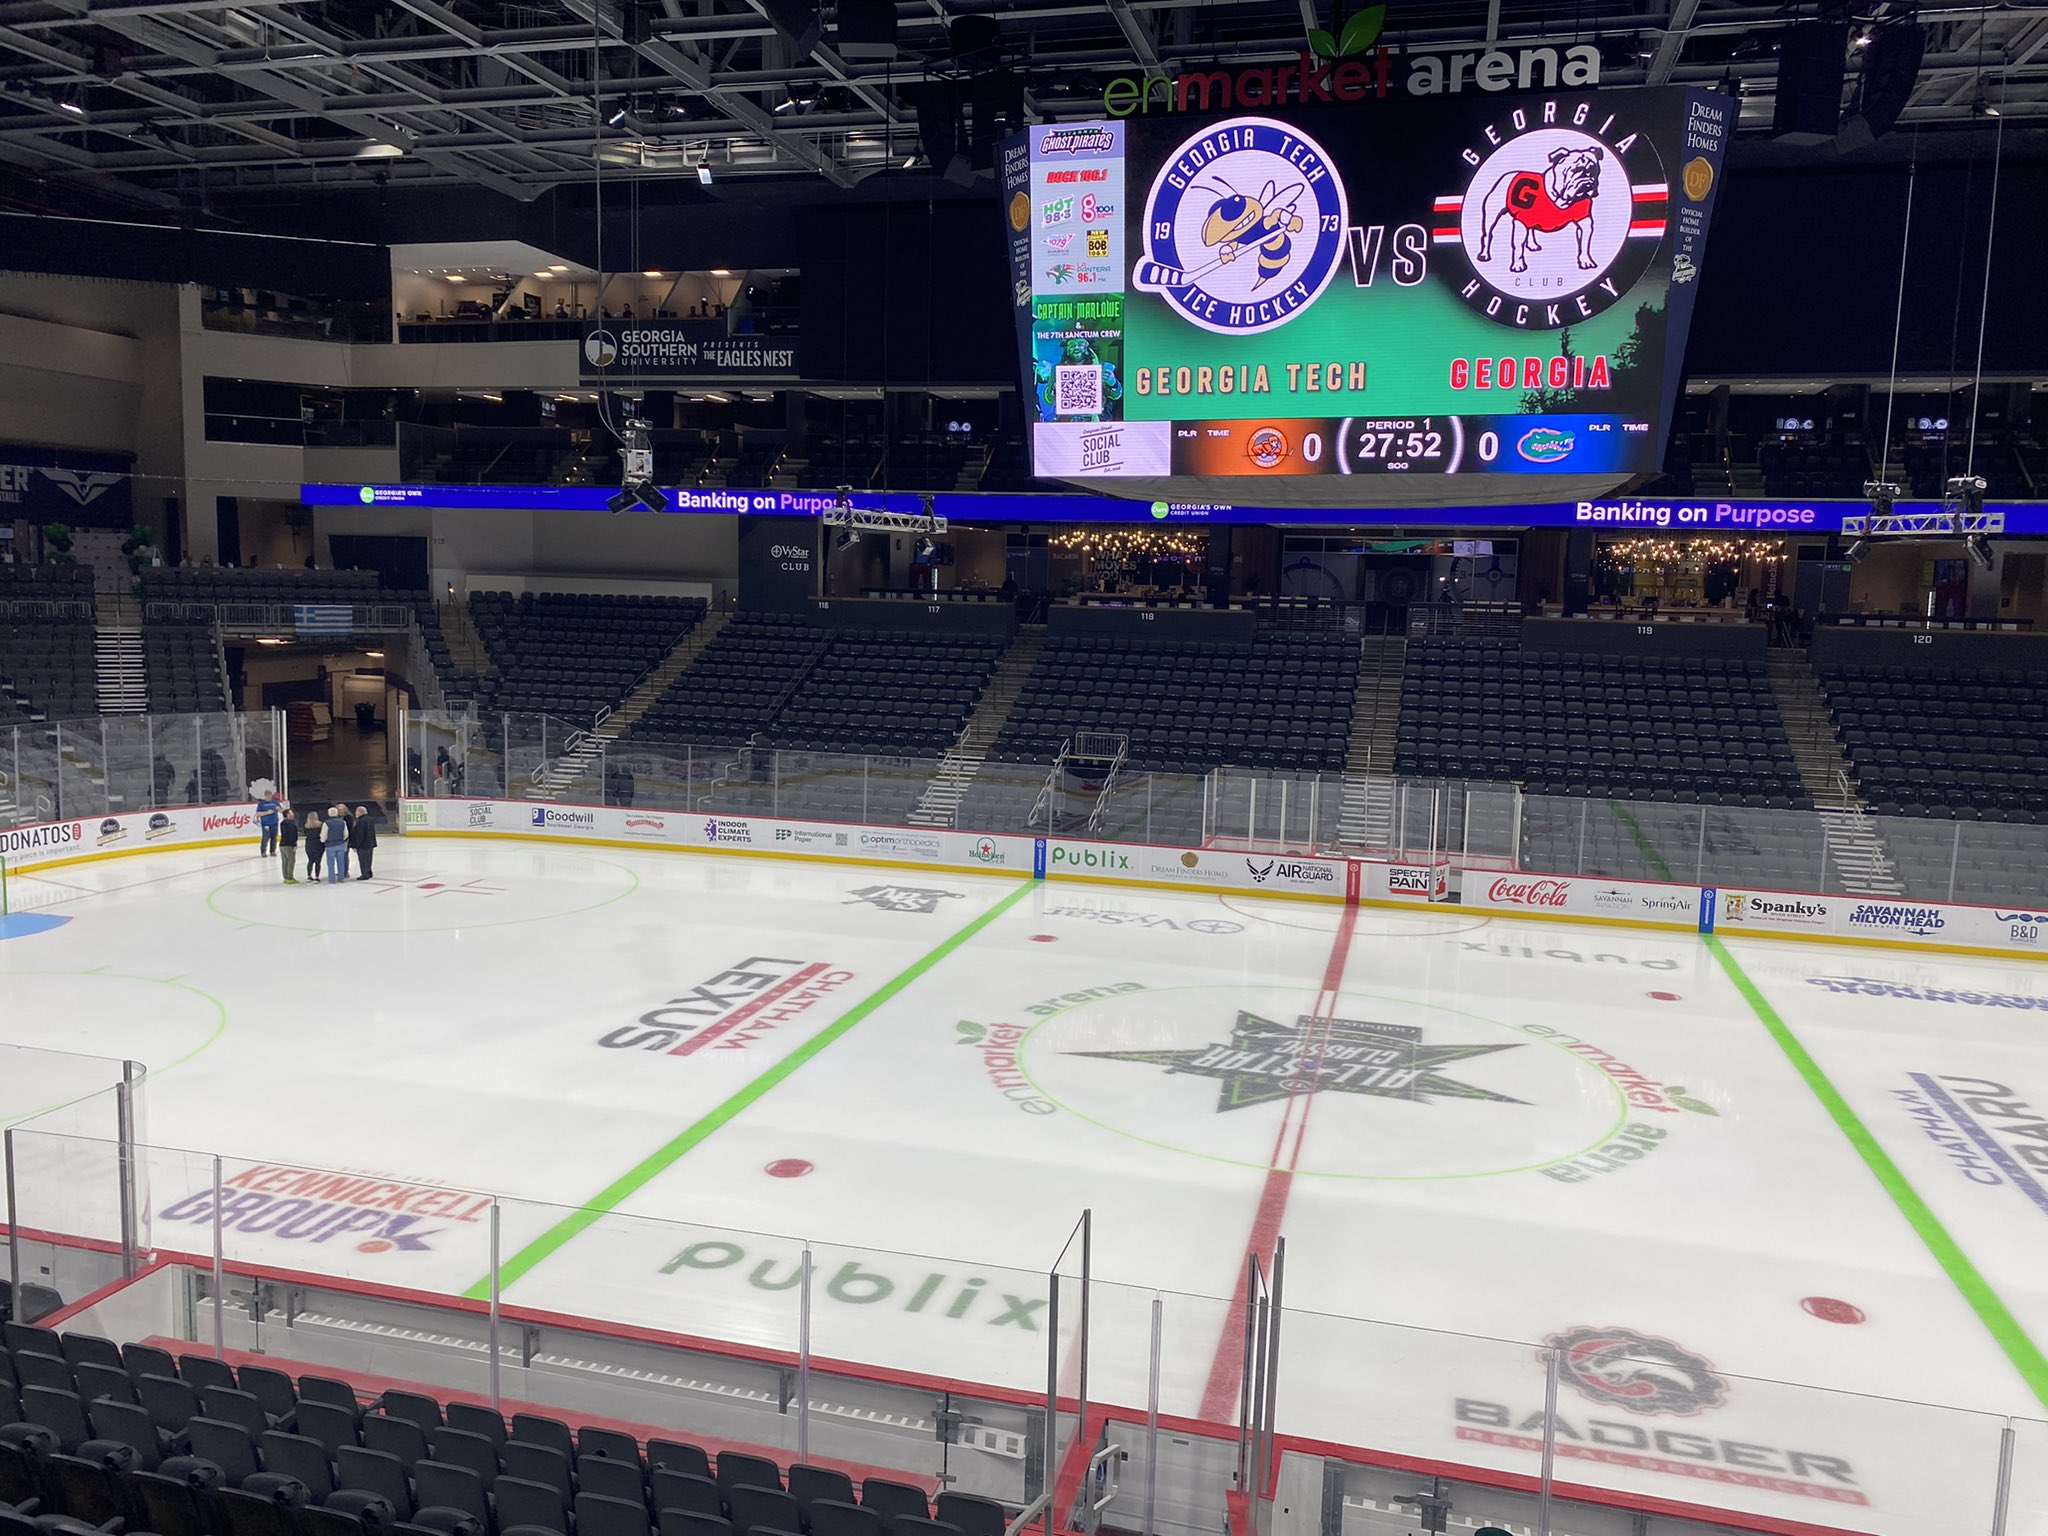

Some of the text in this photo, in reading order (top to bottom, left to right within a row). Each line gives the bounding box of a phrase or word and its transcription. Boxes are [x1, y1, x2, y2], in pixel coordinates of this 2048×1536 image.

[1103, 45, 1602, 117] enmarket arena
[1691, 101, 1723, 122] DREAM
[1461, 101, 1638, 166] GEORGIA
[1688, 117, 1723, 138] FINDERS
[1687, 132, 1719, 152] HOMES
[1004, 144, 1027, 163] DREAM
[1167, 128, 1326, 190] GEORGIA TECH
[1005, 157, 1029, 176] FINDERS
[1007, 171, 1029, 190] HOMES
[1511, 178, 1539, 208] G
[1043, 197, 1074, 215] HOT
[1154, 221, 1171, 241] 19
[1321, 214, 1340, 233] 73
[1088, 240, 1107, 250] BOB
[1346, 223, 1428, 288] VS
[1514, 276, 1564, 288] CLUB
[1037, 301, 1120, 319] CAPTAIN MARLOWE
[1182, 280, 1310, 326] ICE HOCKEY
[1461, 276, 1619, 326] HOCKEY
[1050, 331, 1064, 339] 7TH
[1065, 330, 1100, 339] SANCTUM
[1100, 330, 1121, 338] CREW
[1075, 321, 1082, 329] &
[621, 330, 685, 343] GEORGIA
[621, 343, 698, 357] SOUTHERN
[703, 350, 794, 367] THE EAGLES NEST
[621, 357, 698, 366] UNIVERSITY
[1135, 362, 1367, 395] GEORGIA TECH
[1449, 354, 1612, 390] GEORGIA
[1207, 429, 1230, 437] TIME
[1366, 418, 1430, 430] PERIOD 1
[1589, 423, 1649, 432] PLR TIME
[1083, 433, 1121, 453] SOCIAL
[1303, 433, 1322, 462] 0
[1358, 431, 1441, 458] 27:52
[1478, 431, 1498, 461] 0
[1083, 450, 1110, 467] CLUB
[677, 491, 749, 513] Banking
[753, 495, 776, 510] on
[1170, 503, 1211, 511] GEORGIA'S
[1576, 502, 1816, 529] Banking on Purpose
[782, 545, 809, 557] VyStar
[781, 562, 810, 571] CLUB
[1637, 626, 1653, 635] 119
[1913, 634, 1932, 644] 120
[203, 811, 251, 832] Wendy's
[469, 807, 492, 817] SOCIAL
[469, 815, 486, 824] CLUB
[546, 810, 593, 823] Goodwill
[718, 820, 748, 829] INDOOR
[718, 828, 750, 836] CLIMATE
[0, 824, 71, 853] DONATOS
[718, 835, 752, 843] EXPERTS
[794, 830, 833, 839] International
[794, 836, 812, 844] Paper
[1052, 846, 1130, 869] Publix
[1151, 865, 1176, 873] DREAM
[1204, 869, 1229, 878] HOMES
[1276, 863, 1302, 878] AIR
[1302, 865, 1333, 873] NATIONAL
[1302, 871, 1334, 881] GUARD
[1488, 877, 1571, 907] Coca-Cola
[1594, 894, 1633, 904] SAVANNAH
[1750, 898, 1827, 917] Spanky's
[1856, 904, 1940, 919] SAVANNAH
[1042, 908, 1183, 931] VyStar
[1848, 923, 1916, 931] INTERNATIONAL
[1849, 913, 1945, 928] HILTON HEAD
[2011, 924, 2038, 939] B&D
[598, 955, 806, 1052] LEXUS
[712, 970, 856, 1050] CHATHAM
[976, 1022, 1057, 1115] enmarket
[1024, 981, 1147, 1017] arena
[1332, 1063, 1424, 1089] ALL
[1521, 1023, 1680, 1184] enmarket arena
[1888, 1089, 2003, 1186] CHATHAM
[223, 1164, 494, 1223] KENNICKELL
[158, 1188, 381, 1244] GROUP
[658, 1240, 1049, 1332] publix
[1455, 1401, 1858, 1485] BADGER
